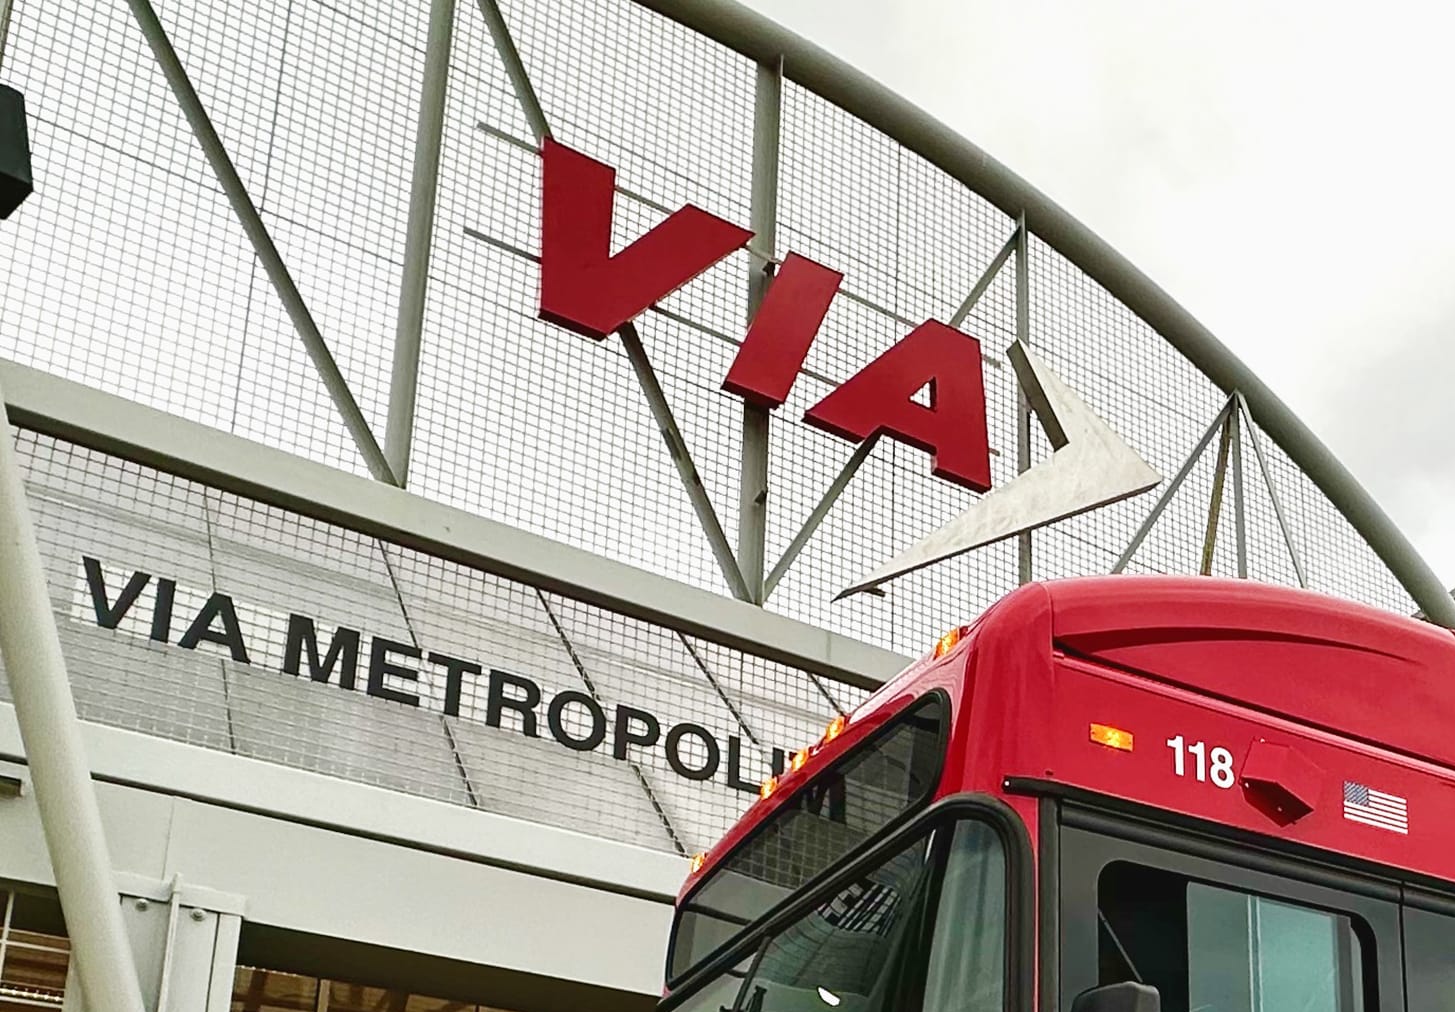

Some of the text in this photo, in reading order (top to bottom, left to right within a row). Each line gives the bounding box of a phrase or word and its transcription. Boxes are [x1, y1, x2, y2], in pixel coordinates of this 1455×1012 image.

[538, 136, 993, 494] VIA
[82, 556, 801, 796] VIA METROPOLI
[1166, 735, 1235, 788] 118
